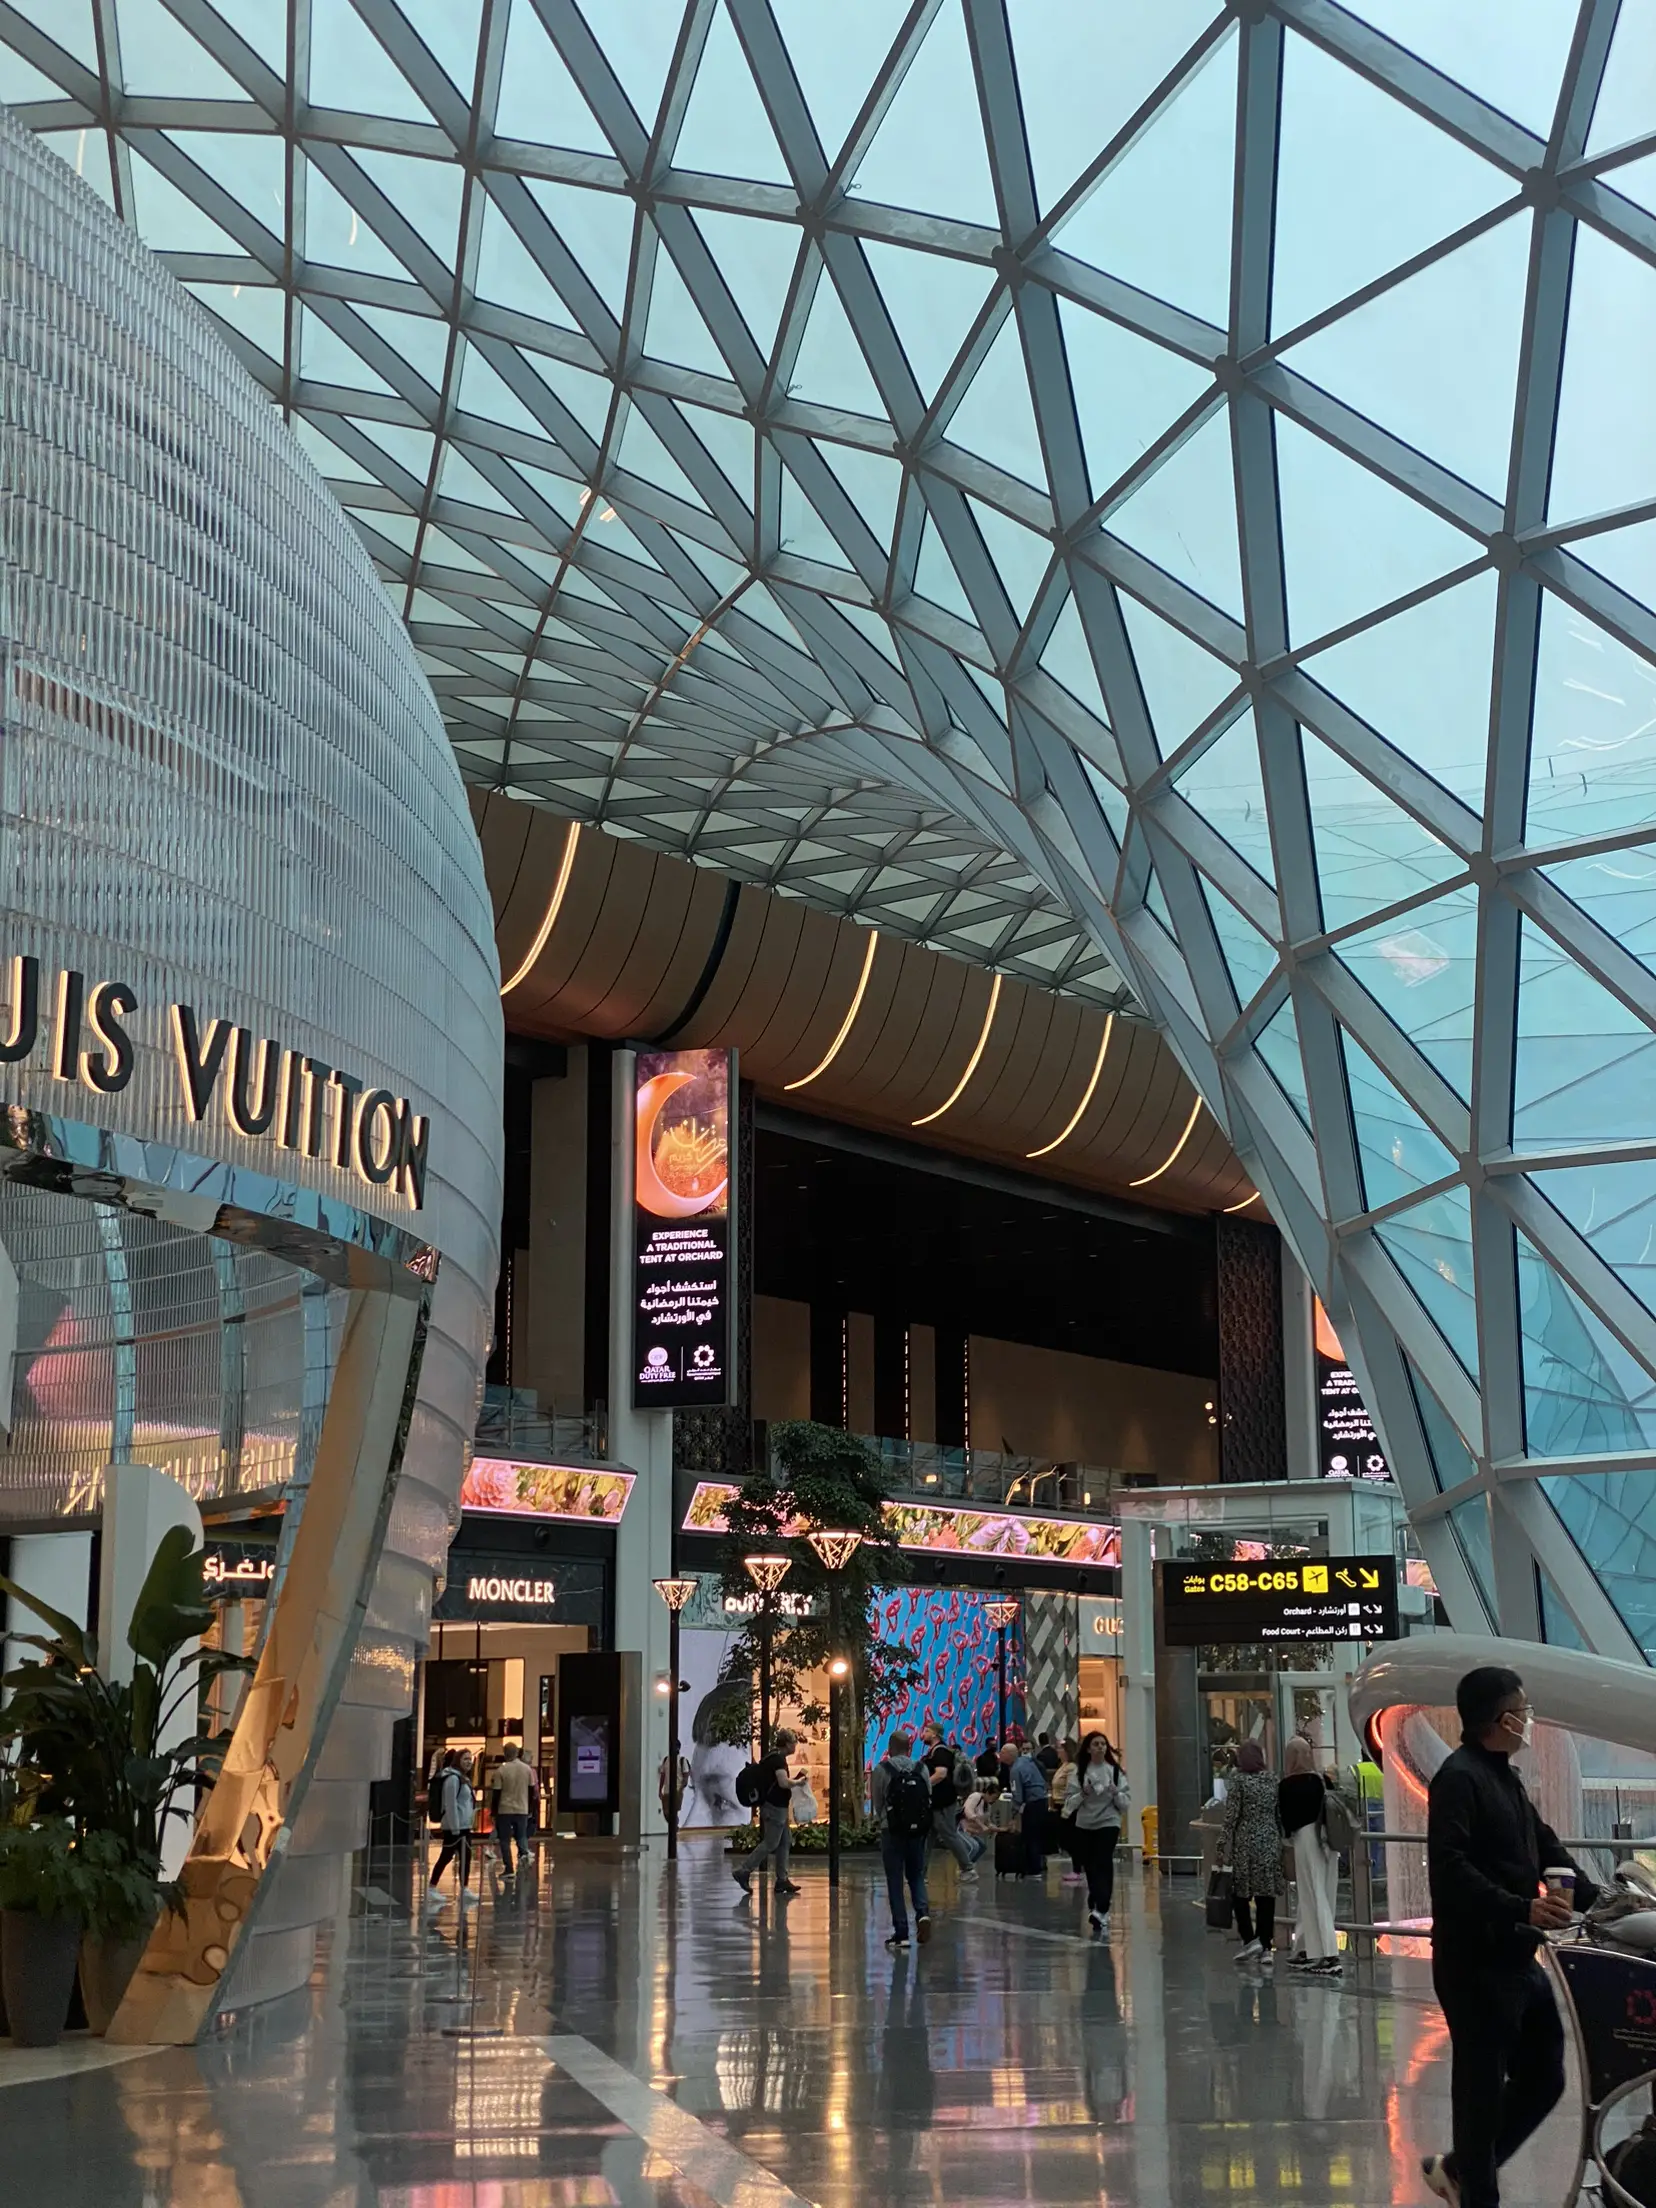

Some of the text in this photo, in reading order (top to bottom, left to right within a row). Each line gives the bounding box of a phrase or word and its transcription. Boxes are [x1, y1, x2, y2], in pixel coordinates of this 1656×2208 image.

[0, 955, 431, 1211] UIS VUITTON
[652, 1229, 709, 1241] EXPERIENCE
[646, 1240, 717, 1253] A TRADITIONAL
[639, 1250, 724, 1264] TENT AT ORCHARD
[671, 1280, 717, 1292] استكشف
[640, 1296, 720, 1311] خيمتنا الرمضانية
[695, 1309, 712, 1326] في
[639, 1371, 677, 1380] DUTY FREE
[643, 1365, 671, 1374] QATAR
[1184, 1571, 1299, 1594] Gates C58-C65
[468, 1577, 556, 1604] MONCLER
[1283, 1607, 1312, 1617] Orchard
[1093, 1615, 1125, 1636] GUC
[1261, 1627, 1301, 1637] Food Court
